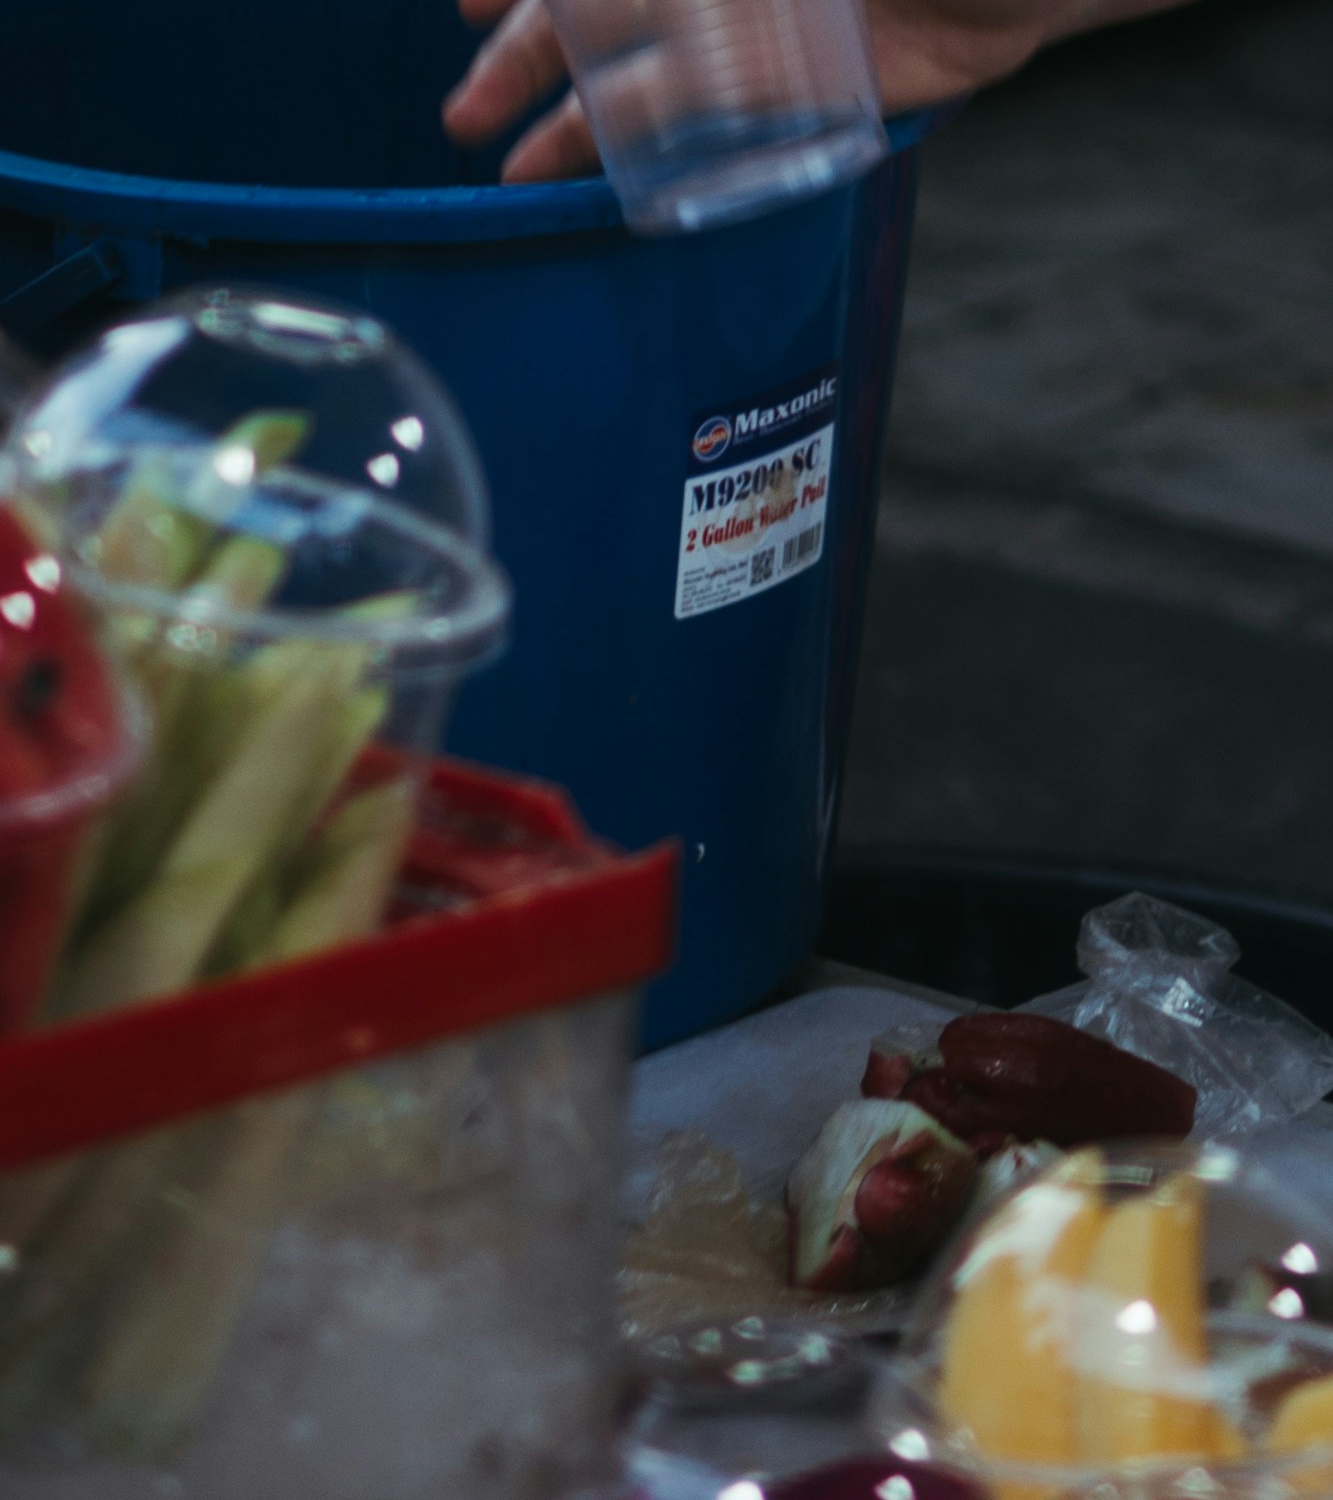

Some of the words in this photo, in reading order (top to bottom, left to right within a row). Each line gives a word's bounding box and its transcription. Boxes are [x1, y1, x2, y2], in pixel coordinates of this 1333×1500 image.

[735, 376, 837, 435] Maxonic
[690, 459, 784, 515] M9200
[792, 438, 821, 474] SC
[686, 530, 697, 552] 2
[703, 517, 754, 546] Gallon
